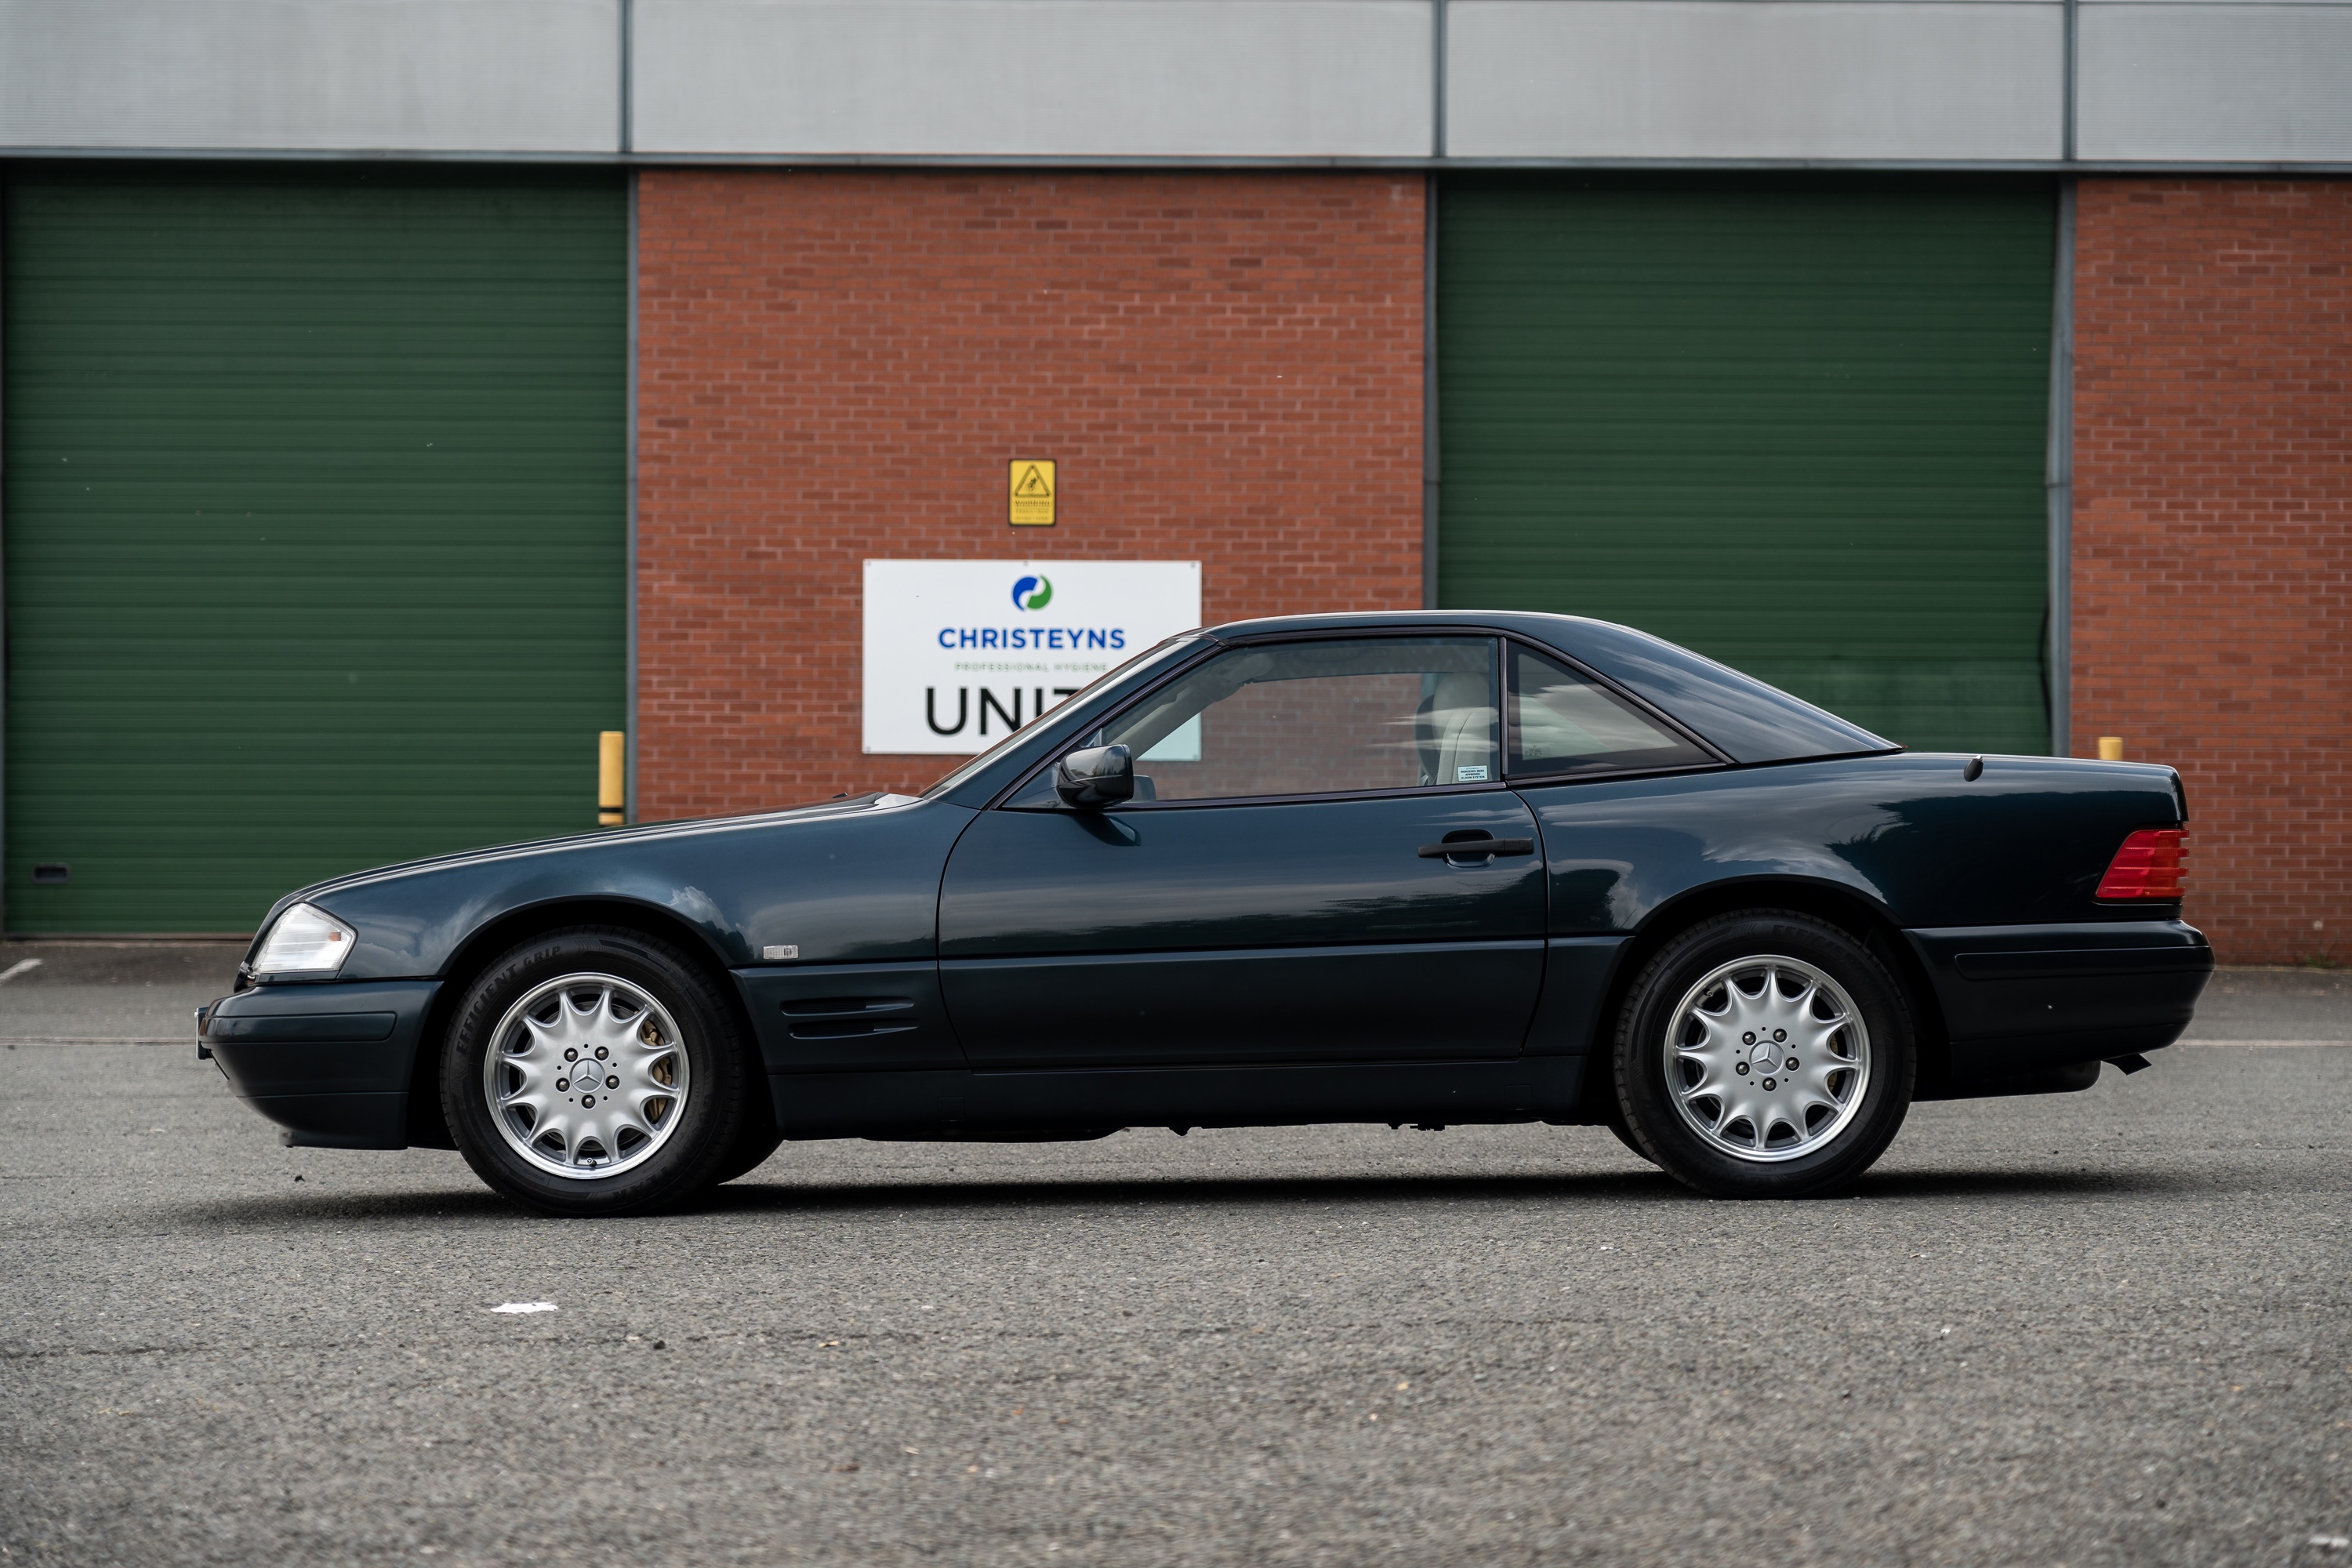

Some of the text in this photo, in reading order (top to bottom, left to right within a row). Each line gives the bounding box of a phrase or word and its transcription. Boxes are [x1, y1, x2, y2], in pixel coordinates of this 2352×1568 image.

[938, 628, 1126, 649] CHRISTEYNS
[954, 662, 1109, 672] PROFESSIONAL HYGIENE
[456, 946, 561, 1055] EFFICIENT GRIP
